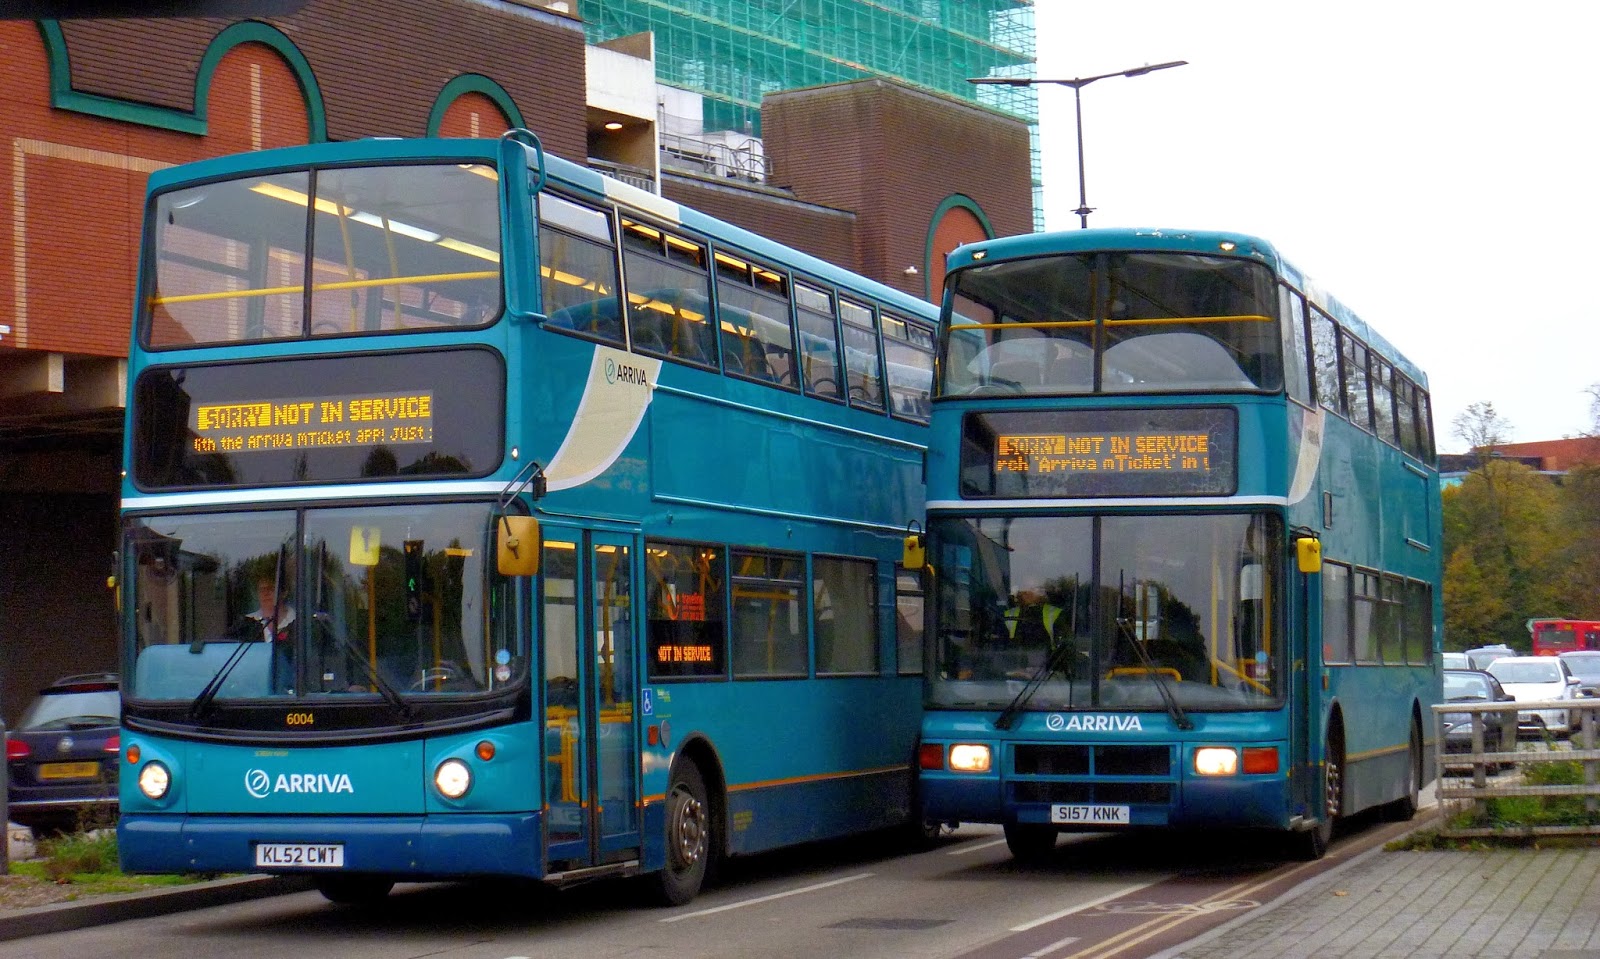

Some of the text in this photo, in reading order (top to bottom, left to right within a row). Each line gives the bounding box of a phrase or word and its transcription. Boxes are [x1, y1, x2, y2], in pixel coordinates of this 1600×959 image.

[617, 364, 648, 387] ARRIVA
[200, 395, 431, 430] SORRY NOT IN SERVICE
[219, 433, 244, 450] the
[247, 431, 293, 450] Arriva
[1000, 434, 1209, 455] SORRY NOT IN SERVICE
[1182, 455, 1198, 470] in
[658, 645, 712, 662] NOT IN SERVICE
[286, 713, 314, 725] 6004
[1065, 715, 1143, 731] ARRIVA
[274, 773, 354, 793] ARRIVA
[1059, 806, 1120, 821] S157 KNK
[263, 846, 337, 863] KL52 CWT
